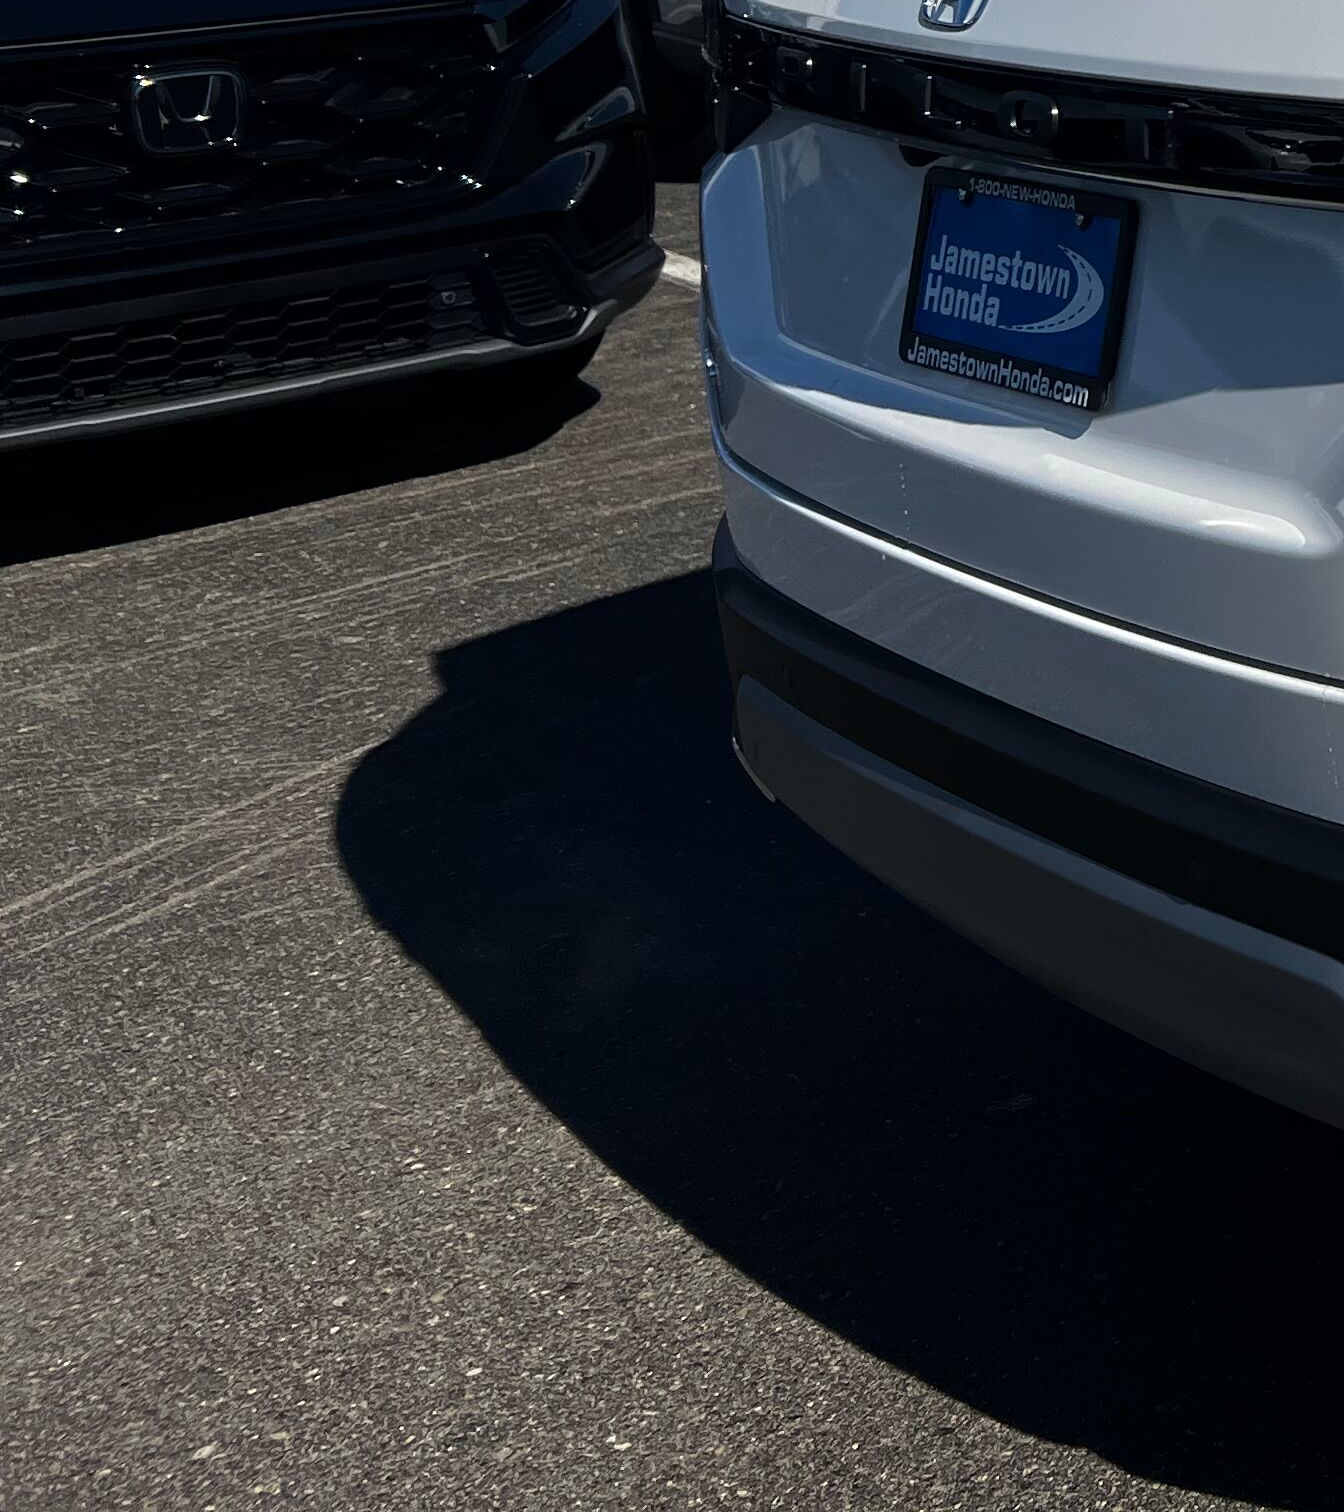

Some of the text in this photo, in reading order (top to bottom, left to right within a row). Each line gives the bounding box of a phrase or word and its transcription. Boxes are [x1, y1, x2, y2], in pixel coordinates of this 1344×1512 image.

[969, 177, 1076, 211] 1-800-NEW-HONDA
[930, 234, 1071, 300] Jamestown
[923, 272, 1001, 327] Honda
[907, 337, 1089, 408] JamestownHonda.com
